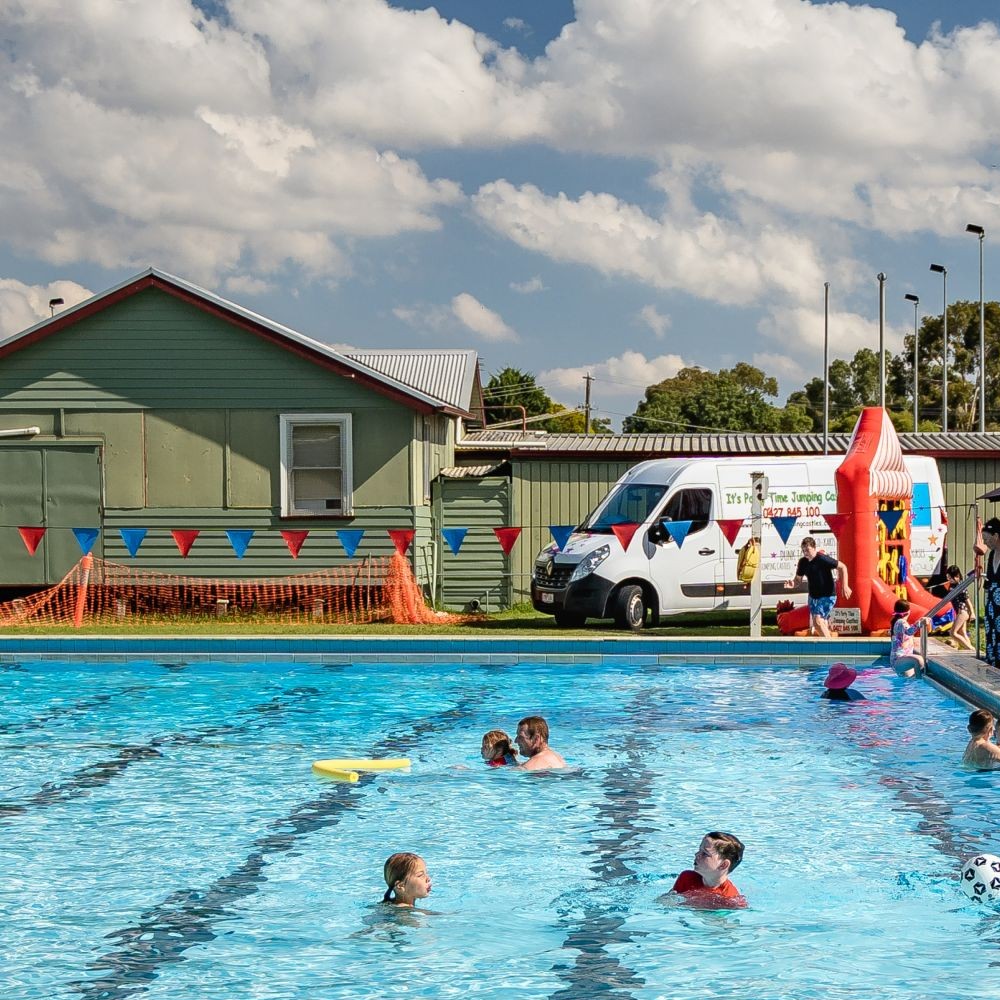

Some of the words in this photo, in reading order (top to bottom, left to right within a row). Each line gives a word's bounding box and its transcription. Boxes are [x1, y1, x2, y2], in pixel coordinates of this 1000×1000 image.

[726, 493, 741, 504] It's
[791, 491, 823, 505] Jumping
[763, 507, 783, 518] 0427
[805, 506, 820, 517] 100
